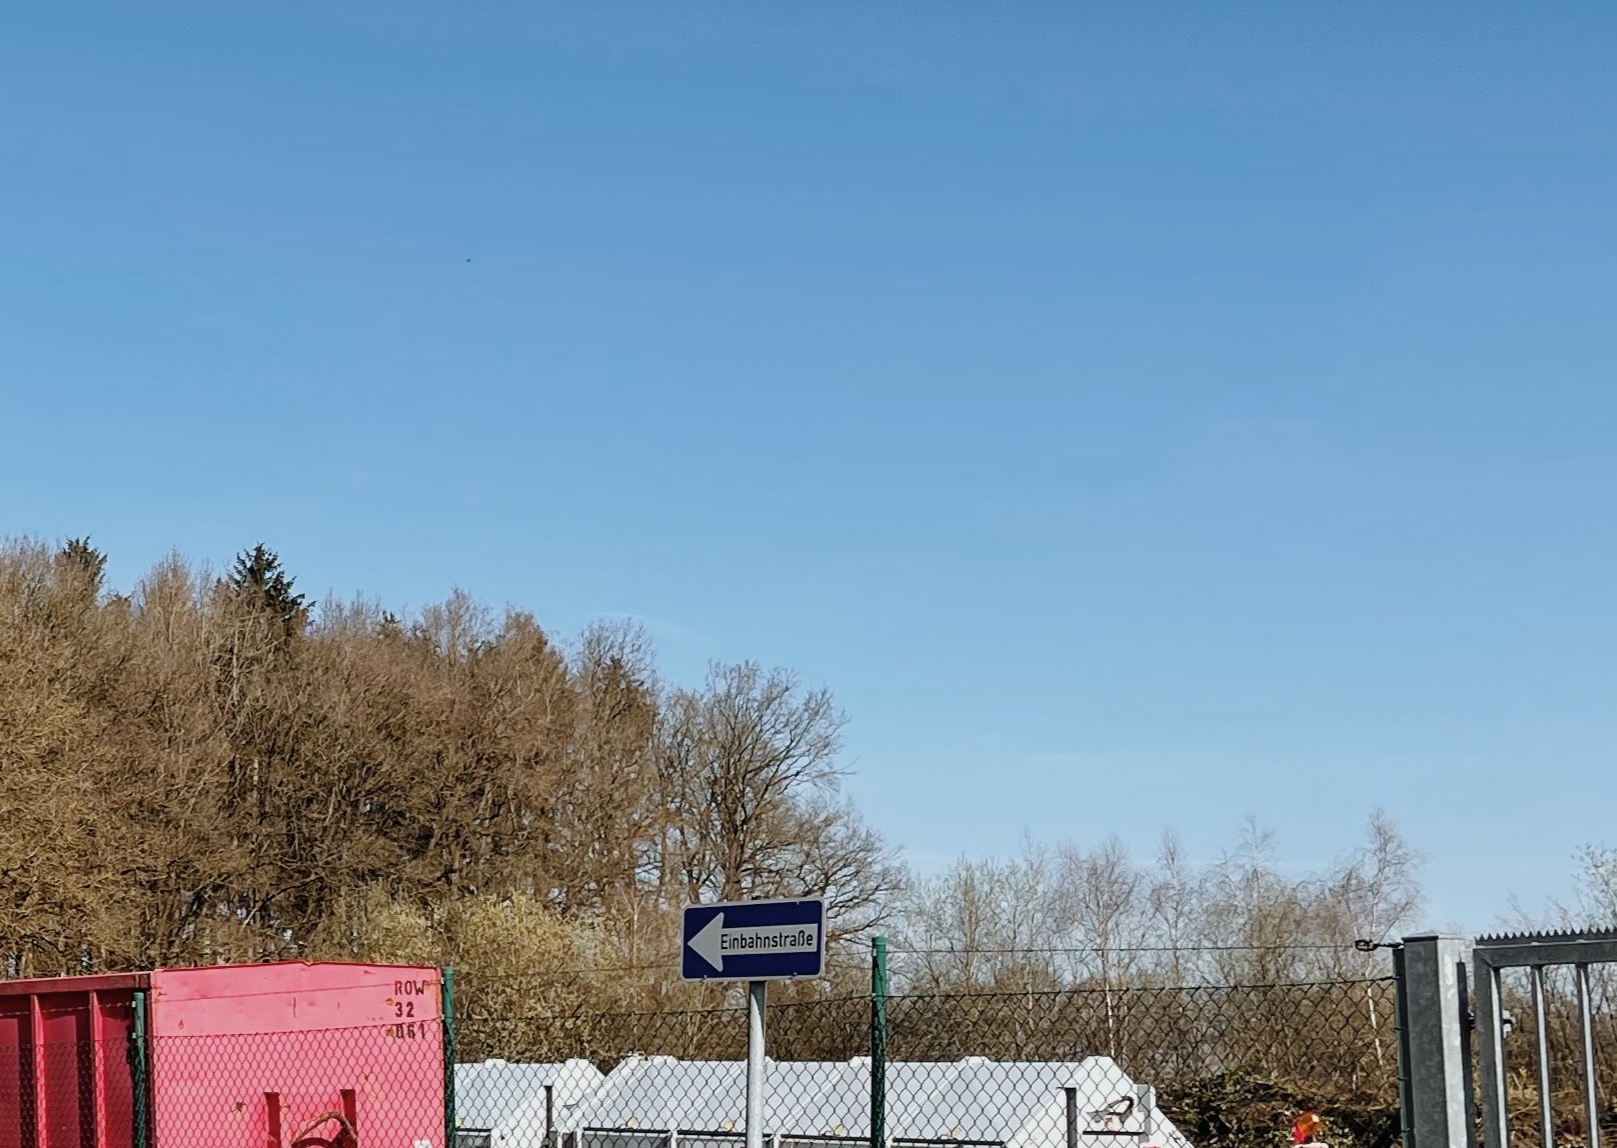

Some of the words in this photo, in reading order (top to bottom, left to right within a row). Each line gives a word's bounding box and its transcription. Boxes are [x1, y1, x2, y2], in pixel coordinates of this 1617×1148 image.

[720, 929, 814, 951] Einbahnstraße
[394, 980, 426, 996] ROW
[394, 1001, 415, 1018] 32
